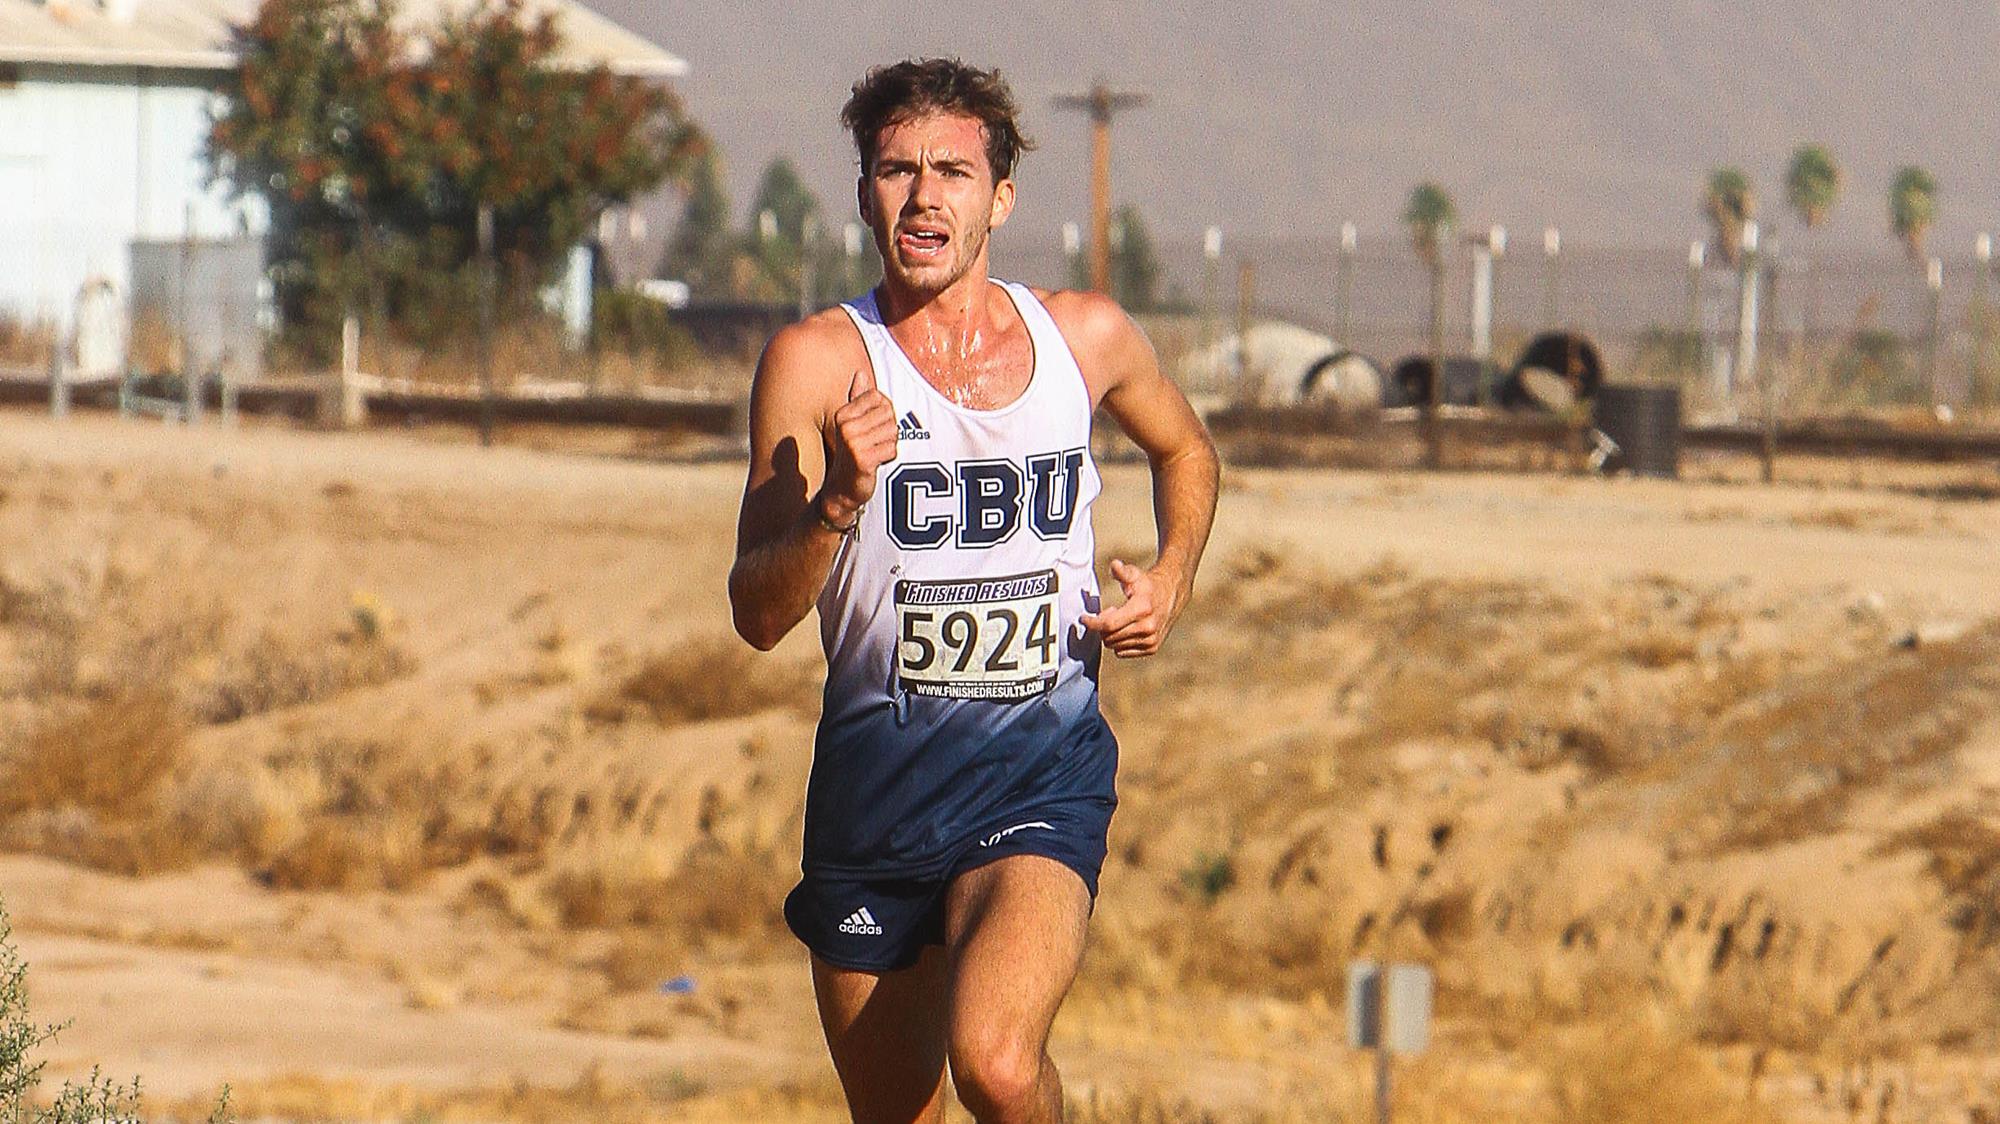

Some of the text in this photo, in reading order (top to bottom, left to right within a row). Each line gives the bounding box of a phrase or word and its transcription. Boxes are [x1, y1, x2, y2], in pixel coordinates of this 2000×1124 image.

[897, 428, 930, 440] didas
[886, 446, 1086, 551] CBU
[905, 575, 1048, 603] FINISHED RESULTS
[902, 603, 1056, 672] 5924
[916, 681, 1045, 698] WWW.FINISHEDRESULTS.COM
[839, 923, 882, 935] adidas
